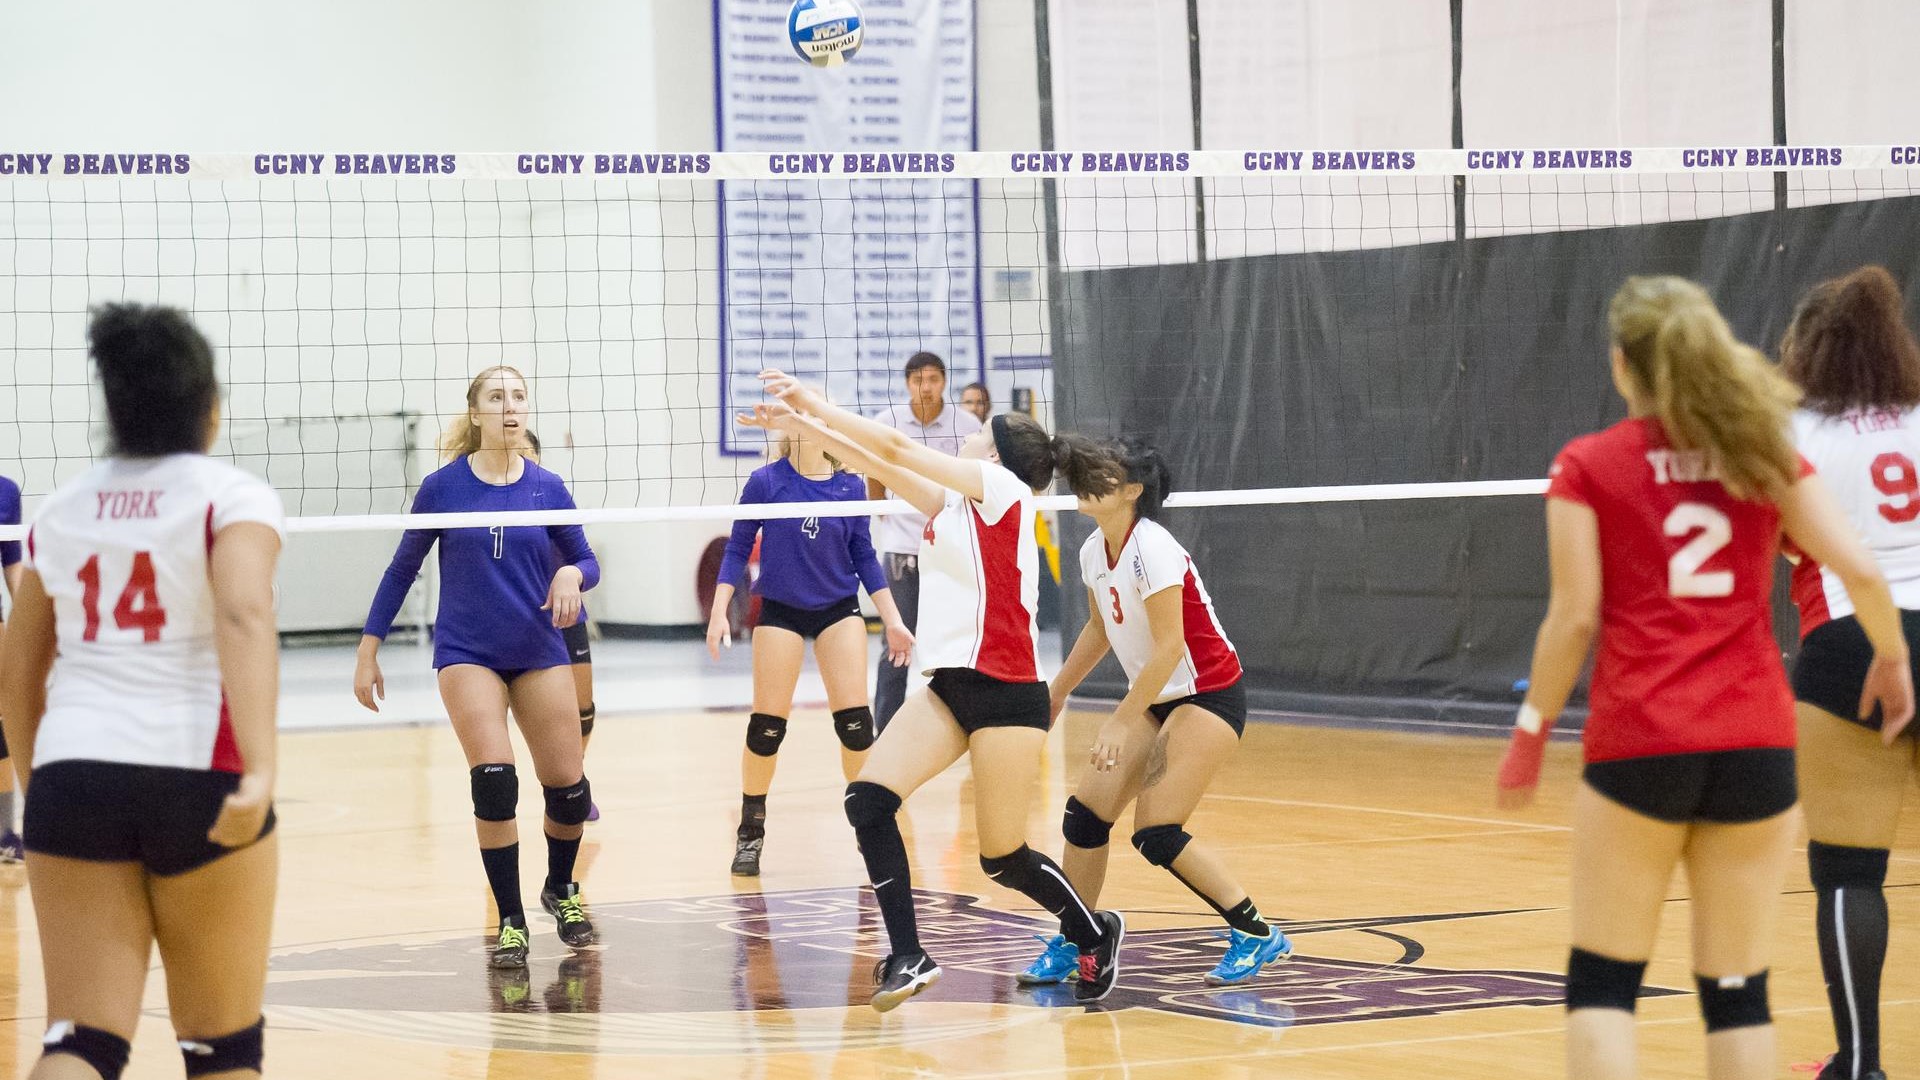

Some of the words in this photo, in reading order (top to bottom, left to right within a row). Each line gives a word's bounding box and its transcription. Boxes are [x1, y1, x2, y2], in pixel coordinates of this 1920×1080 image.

[811, 35, 854, 52] molten
[0, 154, 52, 173] CNY
[63, 154, 190, 173] BEAVERS
[254, 154, 324, 173] CCNY
[335, 154, 456, 173] BEAVERS
[517, 154, 583, 173] CCNY
[594, 153, 711, 172] BEAVERS
[769, 154, 833, 173] CCNY
[843, 153, 955, 172] BEAVERS
[1011, 153, 1071, 172] CCNY
[1081, 152, 1189, 171] BEAVERS
[1243, 151, 1301, 170] CCNY
[1312, 151, 1414, 169] BEAVERS
[1466, 150, 1523, 169] CCNY
[1532, 150, 1632, 168] BEAVERS
[1682, 149, 1738, 167] CCNY
[1746, 147, 1842, 166] BEAVERS
[1890, 146, 1920, 165] CC
[1869, 451, 1920, 524] 9
[96, 489, 165, 521] YORK
[801, 516, 820, 539] 4
[489, 525, 504, 559] 1
[1662, 501, 1735, 598] 2
[77, 551, 167, 643] 14
[1109, 586, 1124, 625] 3
